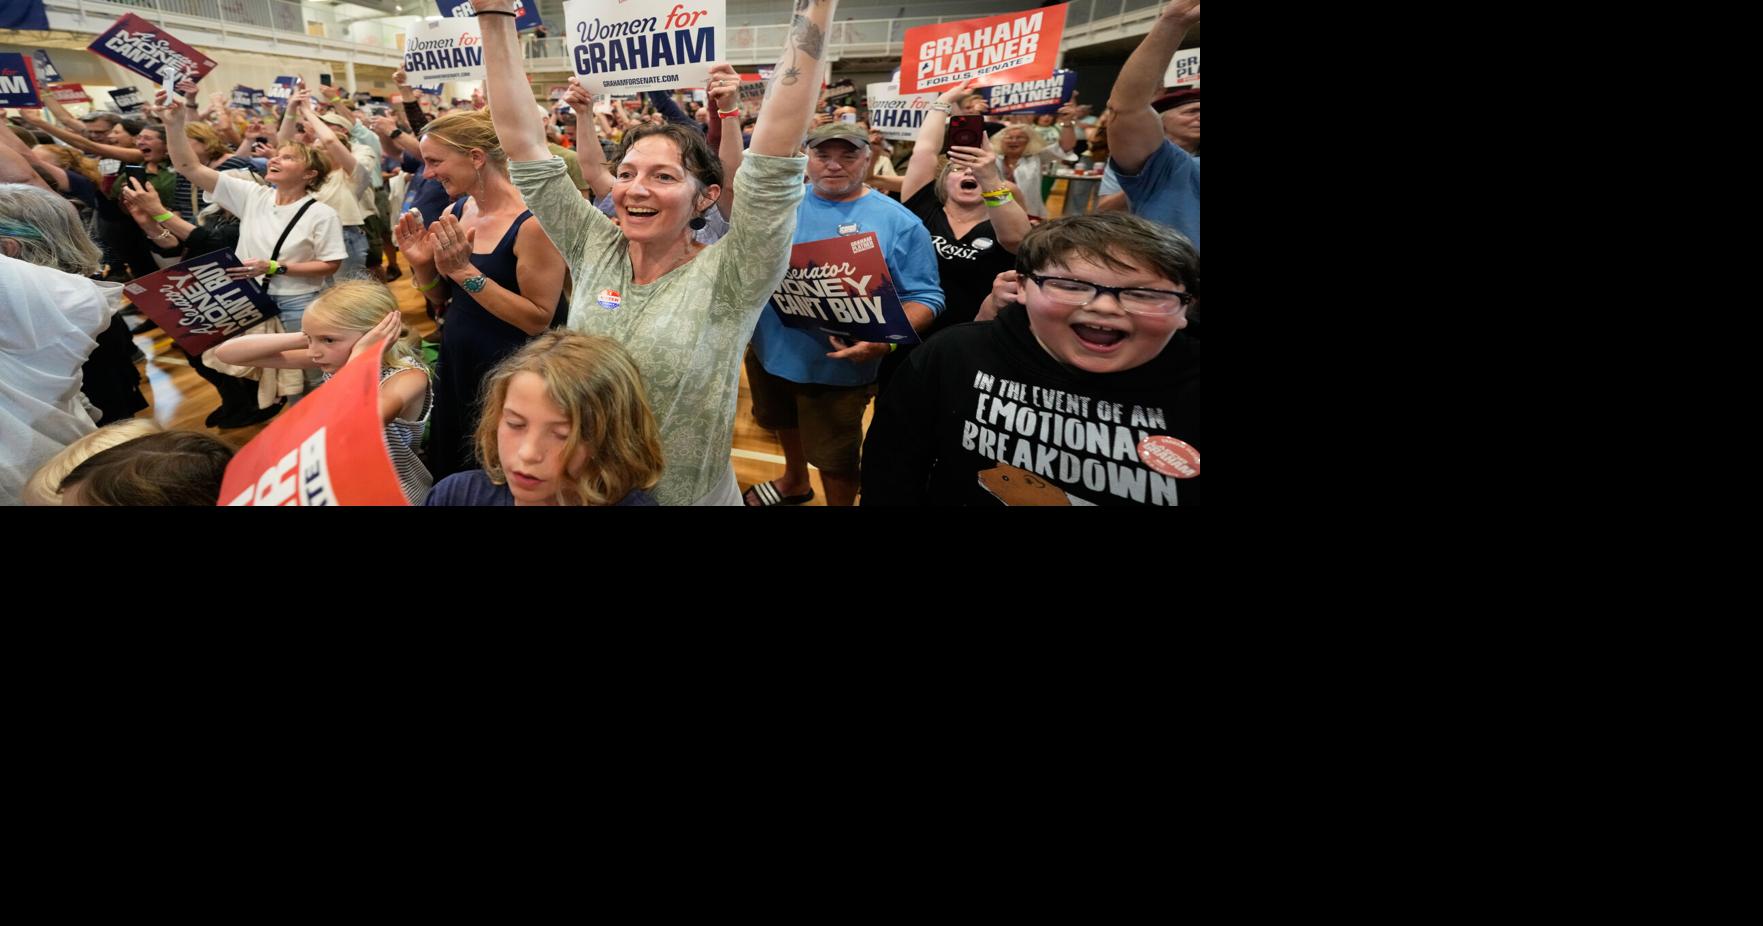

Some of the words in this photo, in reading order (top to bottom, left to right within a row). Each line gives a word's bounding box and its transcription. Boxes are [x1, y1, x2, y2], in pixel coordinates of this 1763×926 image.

[407, 37, 454, 51] Women
[458, 32, 481, 46] for
[577, 17, 657, 43] Women
[664, 4, 707, 30] for
[919, 11, 1043, 61] GRAHAM
[105, 37, 161, 69] CAN'T
[115, 29, 200, 76] MONEY
[574, 26, 715, 76] GRAHAM
[917, 33, 1040, 79] PLATNER
[603, 74, 679, 88] GRAHAMFORSENATE.COM
[926, 75, 949, 87] FOR
[952, 72, 974, 82] U.S.
[977, 58, 1023, 77] SENATE
[991, 75, 1065, 98] GRAHAM
[911, 96, 929, 109] for
[990, 87, 1063, 108] PLATNER
[188, 261, 233, 292] BUY
[167, 273, 240, 336] MONEY
[217, 287, 263, 327] CAN'T
[772, 293, 829, 321] CAN'T
[827, 296, 886, 324] BUY
[972, 369, 995, 393] IN
[999, 378, 1028, 404] THE
[1032, 385, 1091, 418] EVENT
[1096, 400, 1124, 425] OF
[1130, 404, 1167, 430] AN
[975, 392, 1149, 463] EMOTIONA
[961, 419, 1179, 506] BREAKDOWN
